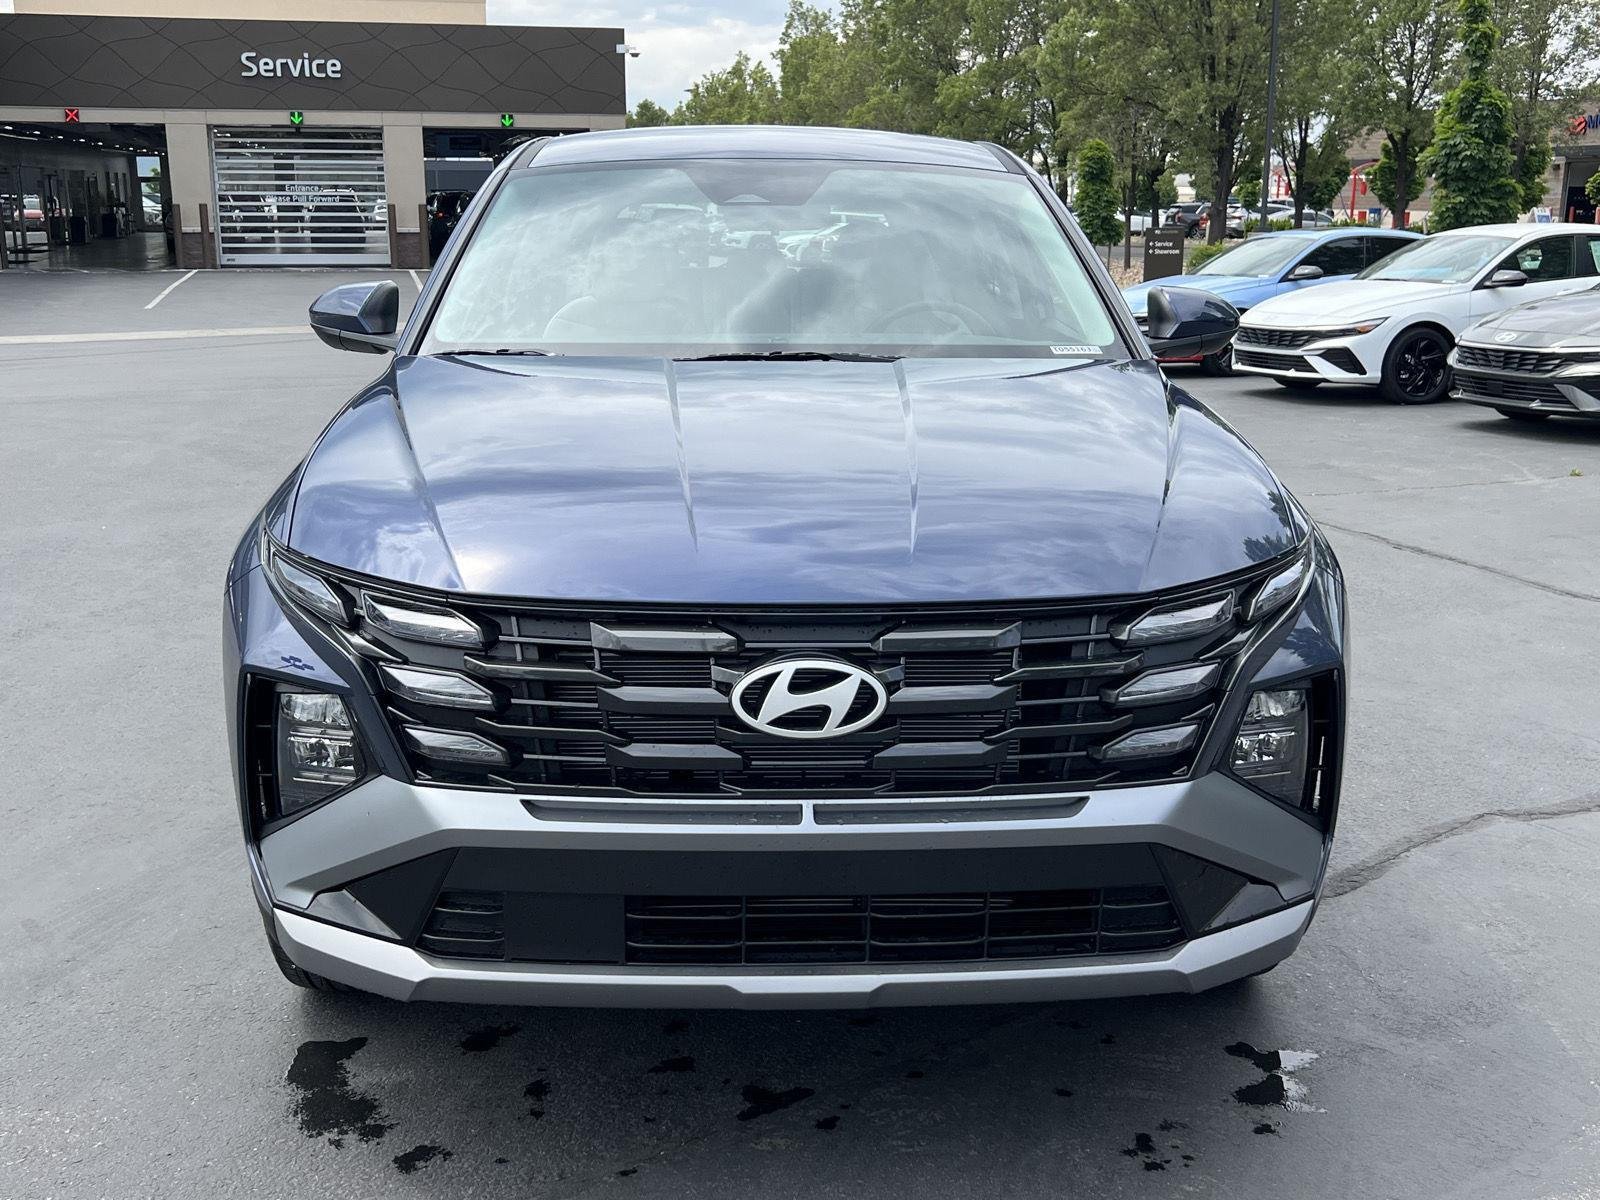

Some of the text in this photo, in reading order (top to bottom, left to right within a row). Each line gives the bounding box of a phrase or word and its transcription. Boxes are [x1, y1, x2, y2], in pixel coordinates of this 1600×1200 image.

[240, 51, 342, 78] Service
[286, 184, 319, 192] Entrance
[293, 195, 307, 203] Pull
[309, 195, 340, 203] Forward
